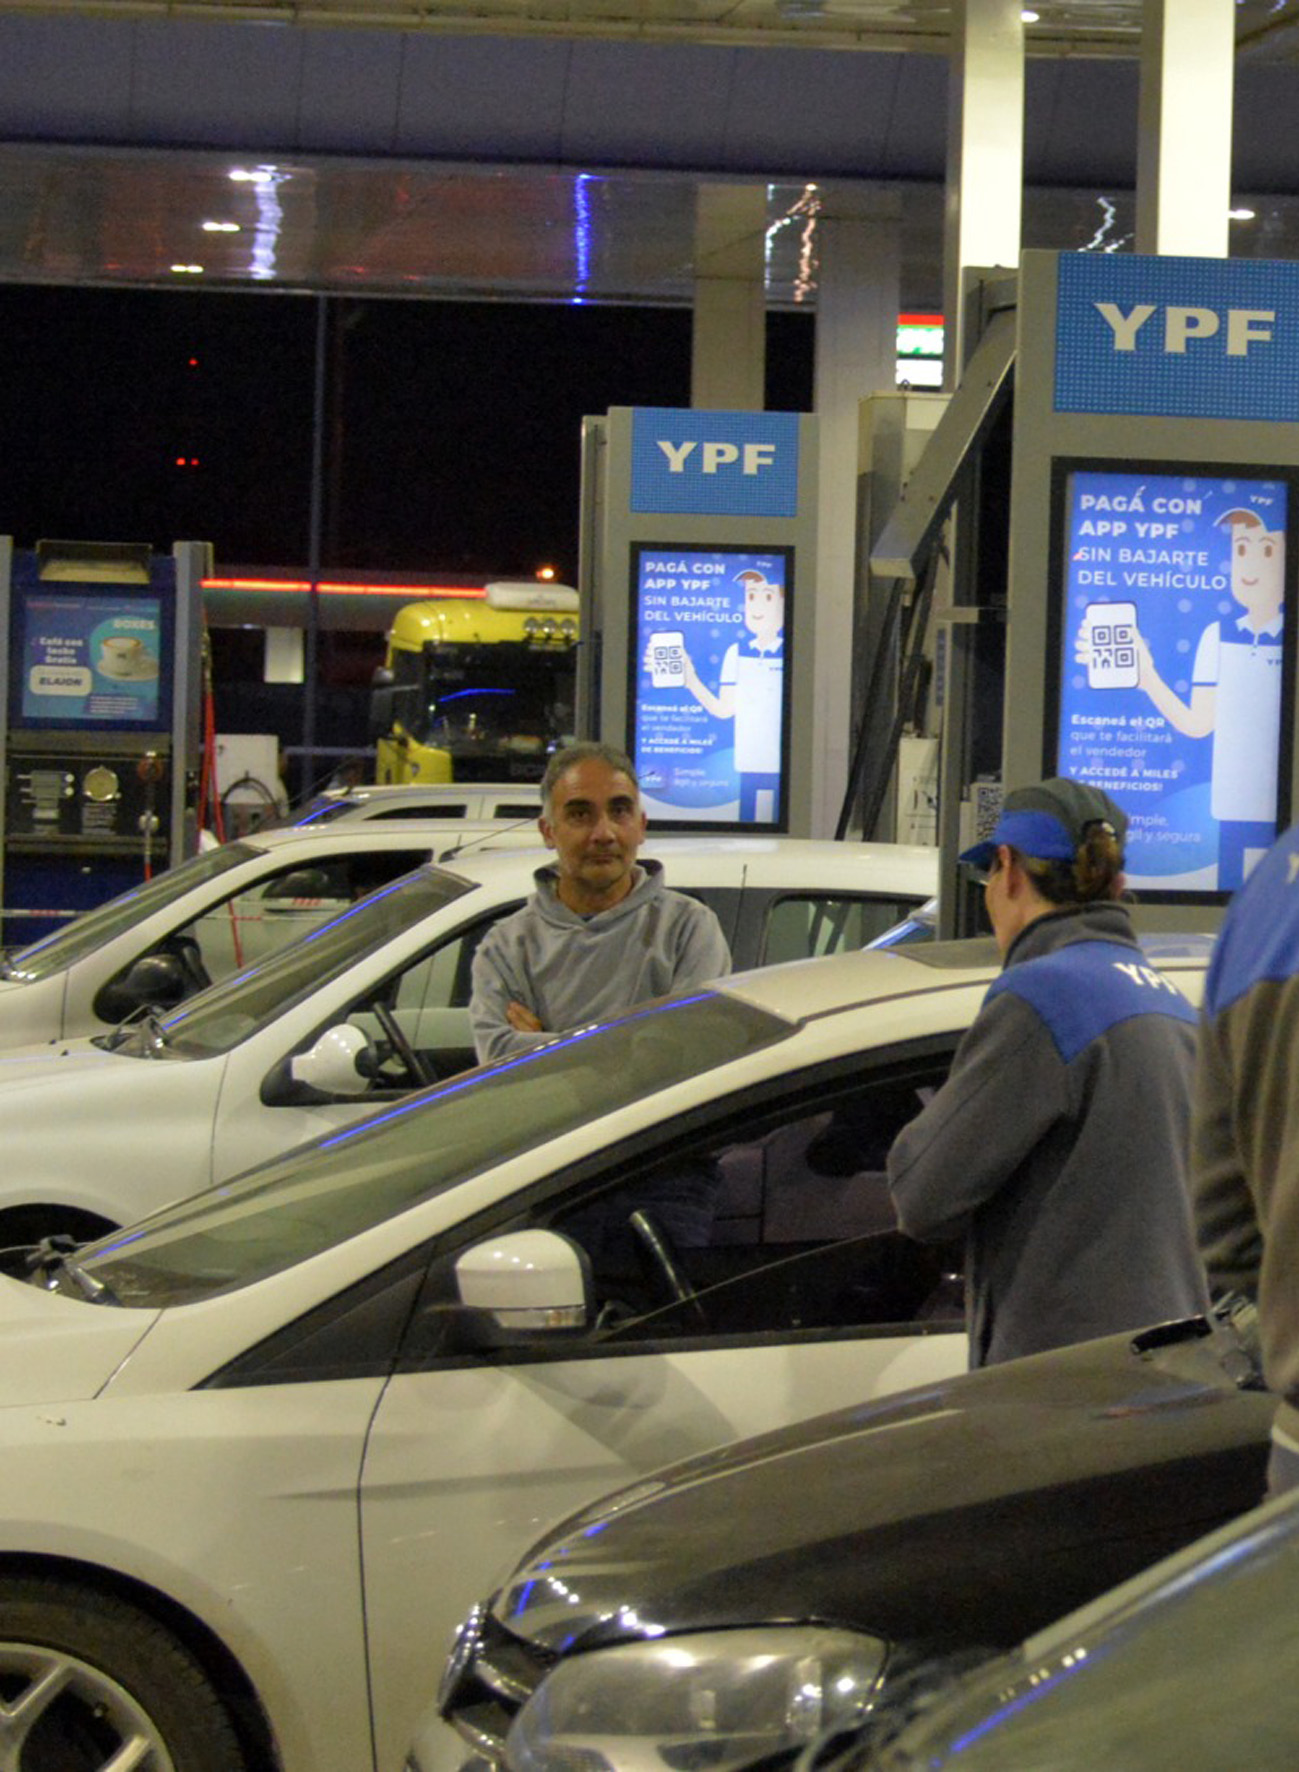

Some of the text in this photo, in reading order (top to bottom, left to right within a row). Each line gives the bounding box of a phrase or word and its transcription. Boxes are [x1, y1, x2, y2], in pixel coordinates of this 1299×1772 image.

[1095, 302, 1275, 356] YPF
[657, 441, 776, 475] YPF
[1080, 492, 1203, 515] PAGÁ CON
[1079, 520, 1180, 539] APP YPF
[1079, 547, 1209, 567] SIN BAJARTE
[645, 560, 726, 575] PAGÁ CON
[644, 578, 711, 590] APP YPF
[1078, 570, 1227, 590] DEL VEHÍCULO
[644, 595, 731, 608] SIN BAJARTE
[644, 610, 743, 623] DEL VEHÍCULO
[1071, 714, 1166, 729] Escaneá el QR
[1070, 730, 1173, 743] que te facilitará
[1069, 746, 1147, 758] el vendedor
[1069, 766, 1179, 779] Y ACCEDÉ A MILES
